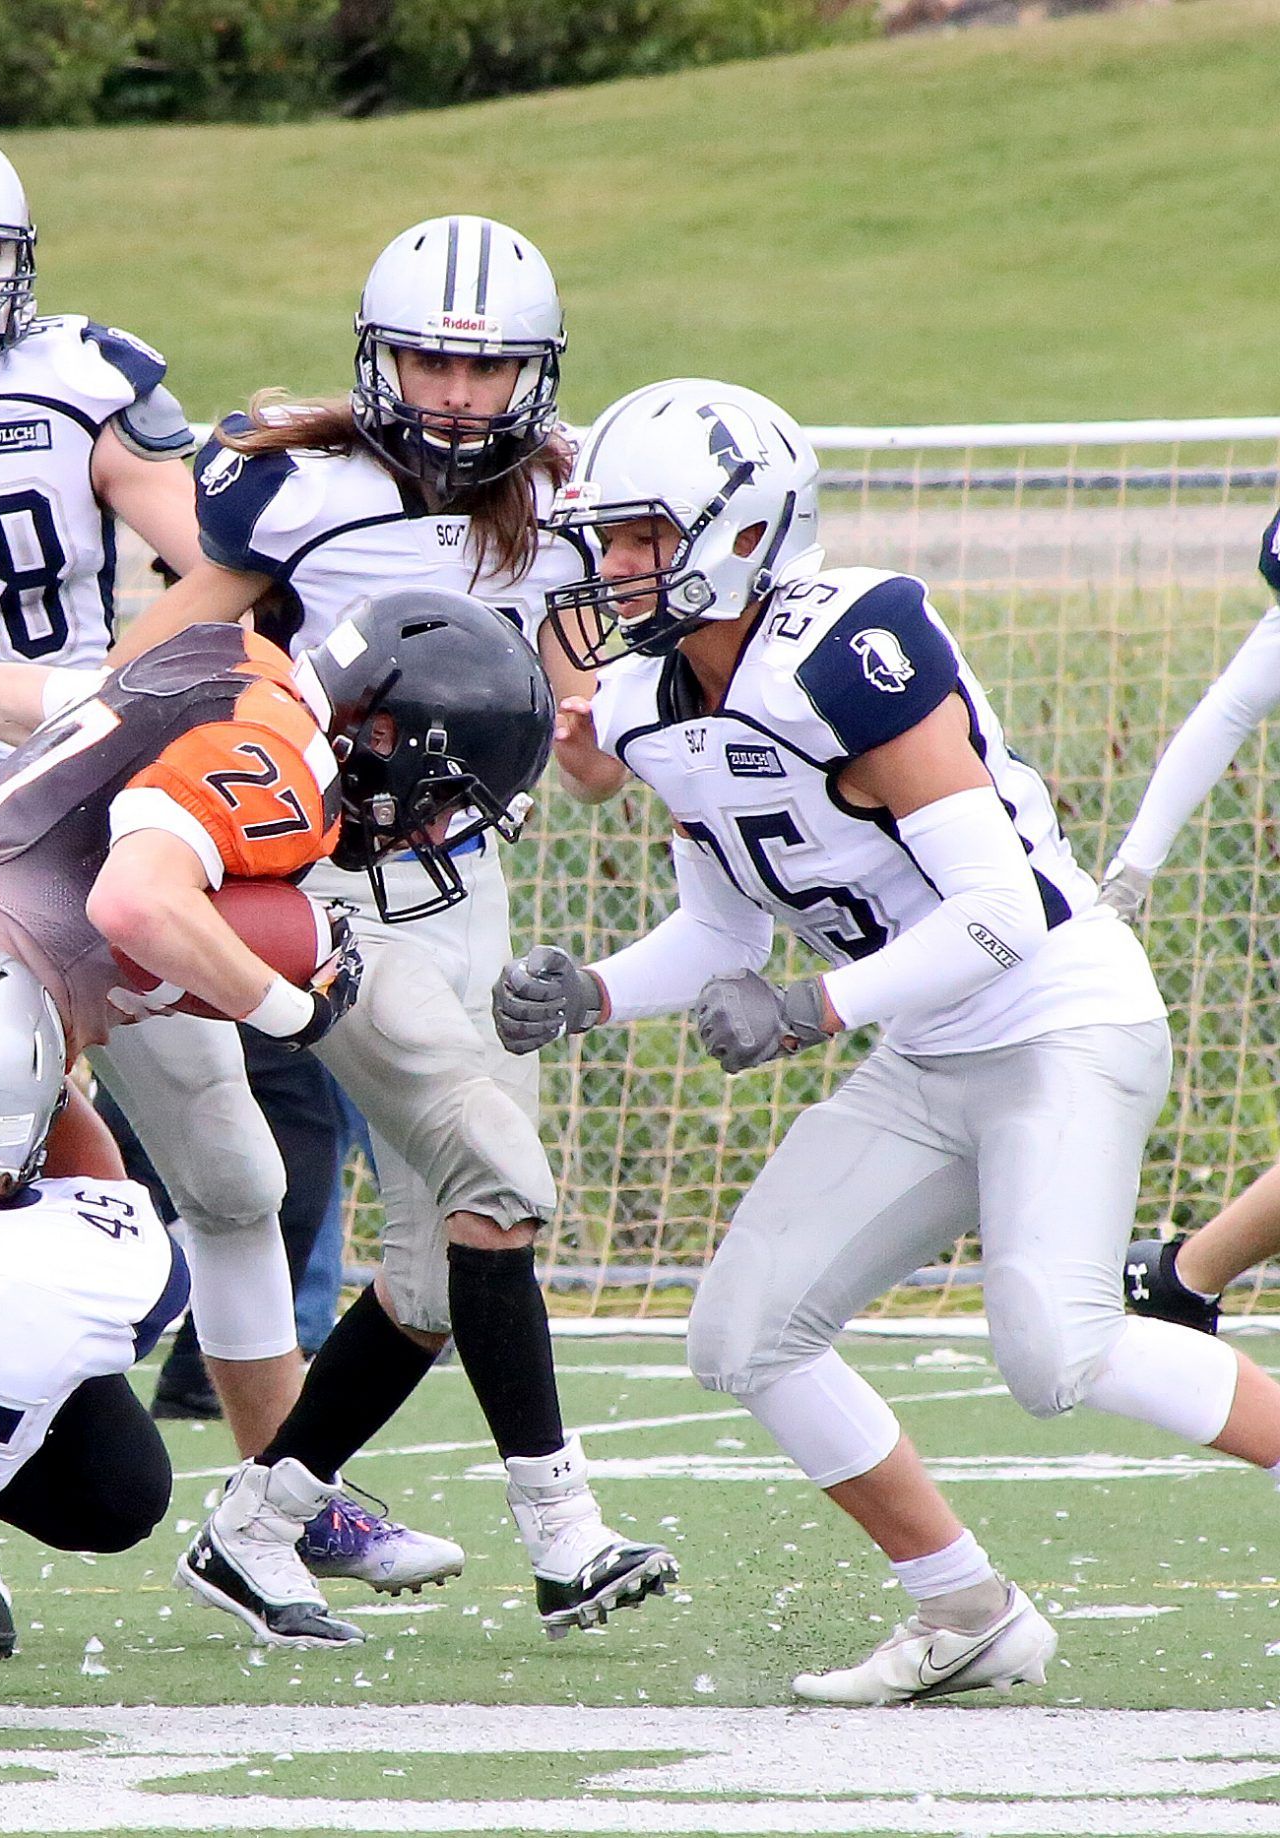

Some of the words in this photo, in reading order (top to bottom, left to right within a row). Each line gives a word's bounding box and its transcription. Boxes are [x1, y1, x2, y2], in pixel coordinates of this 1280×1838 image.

[443, 317, 486, 331] Riddell
[201, 741, 313, 841] 27
[74, 1191, 139, 1239] 45
